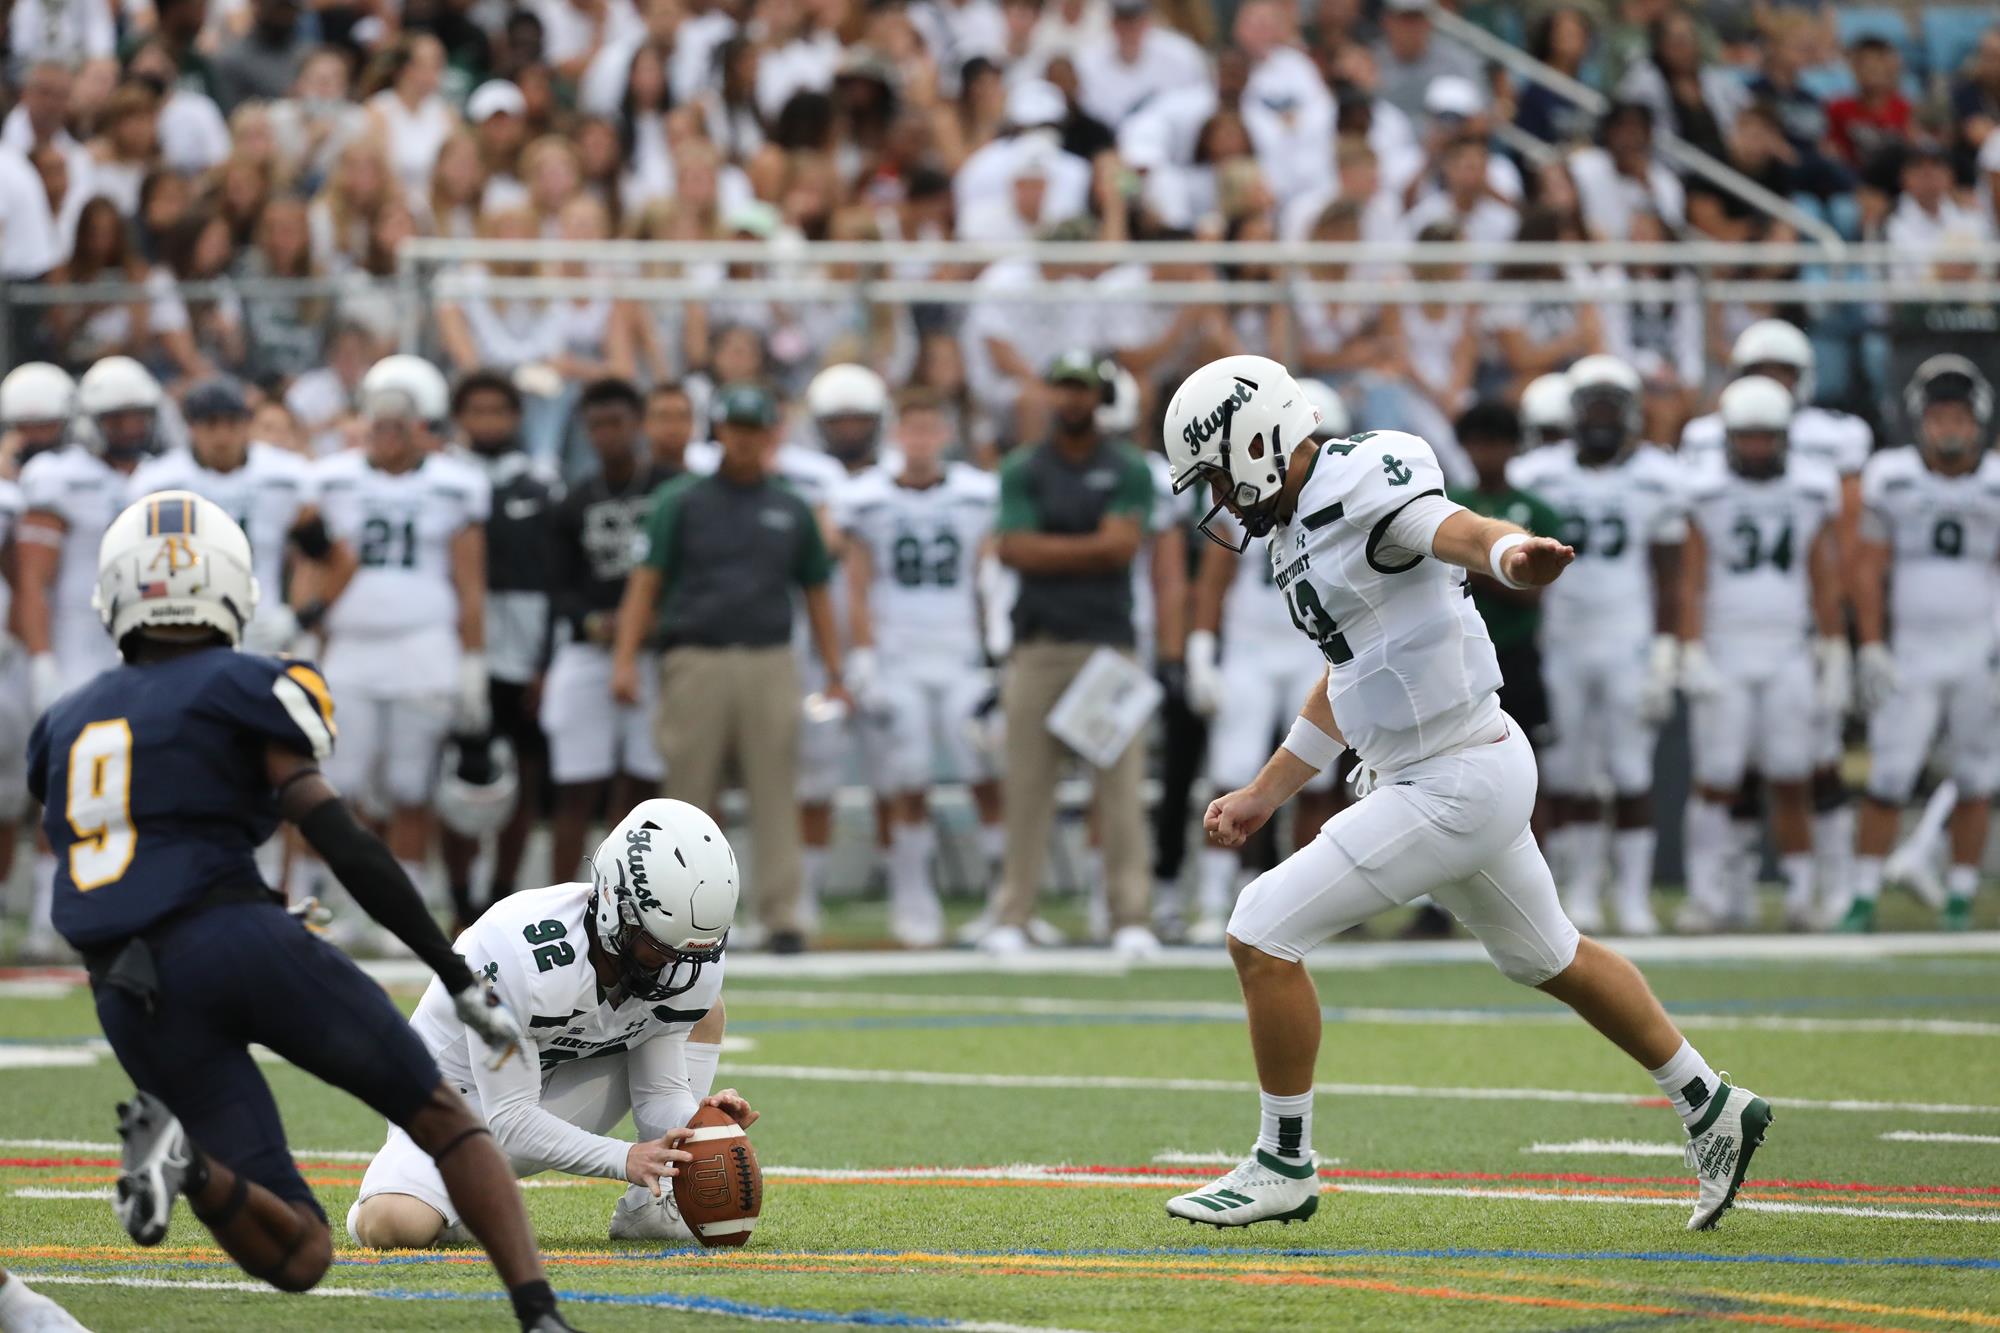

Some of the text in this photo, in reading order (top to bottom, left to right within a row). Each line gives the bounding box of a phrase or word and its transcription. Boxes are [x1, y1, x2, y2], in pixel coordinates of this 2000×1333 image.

[361, 517, 416, 570] 21
[1729, 515, 1793, 573] 34
[66, 717, 138, 892] 9
[626, 829, 662, 913] Hurst
[523, 919, 576, 973] 92
[1700, 1135, 1726, 1173] THREE
[1709, 1136, 1735, 1180] STRIPE
